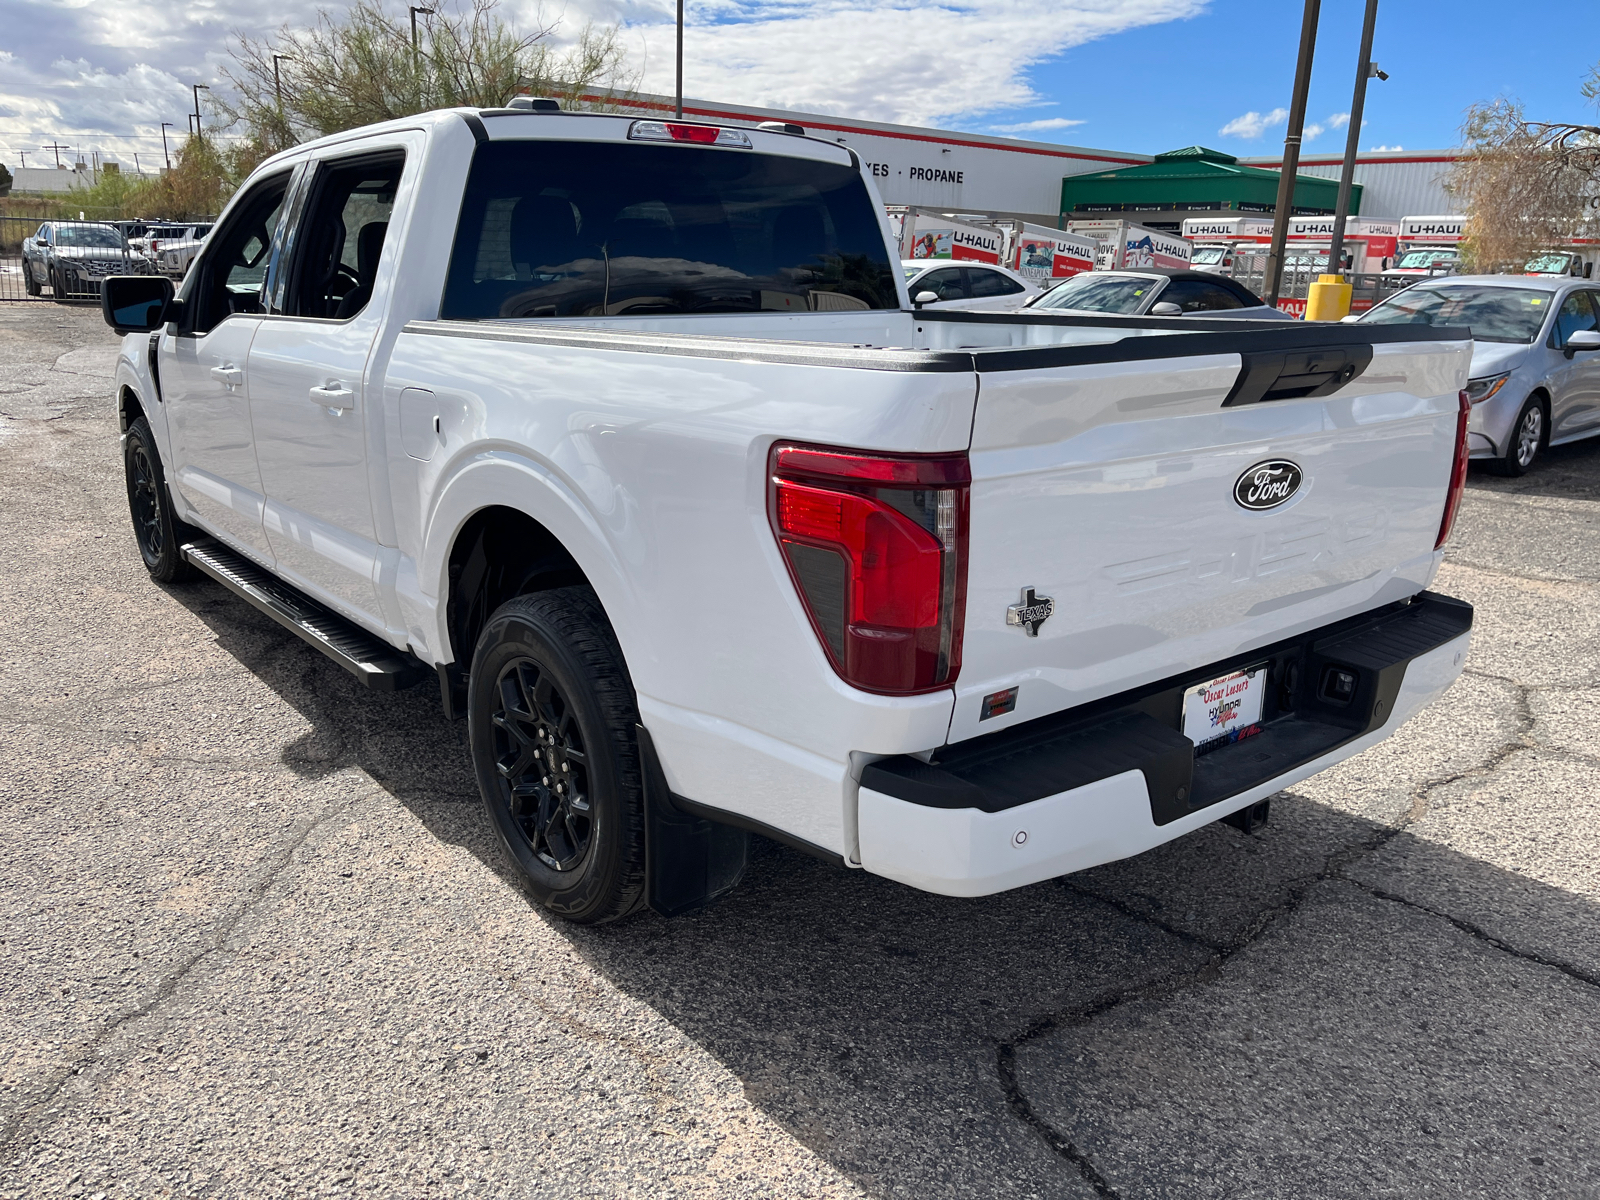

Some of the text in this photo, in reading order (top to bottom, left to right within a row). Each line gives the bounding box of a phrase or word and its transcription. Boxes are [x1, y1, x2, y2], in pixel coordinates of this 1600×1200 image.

[909, 166, 964, 184] PROPANE
[1190, 225, 1232, 234] U-HAUL
[1295, 224, 1334, 234] U-HAU
[1369, 225, 1393, 234] U-HAUL
[953, 231, 996, 251] U-HAUL
[1058, 243, 1091, 258] U-HAUL
[1098, 244, 1115, 255] OVE
[1156, 241, 1188, 259] U-HAUL
[1247, 468, 1293, 503] Ford
[1017, 602, 1053, 622] TEXAS
[1203, 689, 1225, 704] Oscar
[1208, 698, 1242, 718] HYUNDAI
